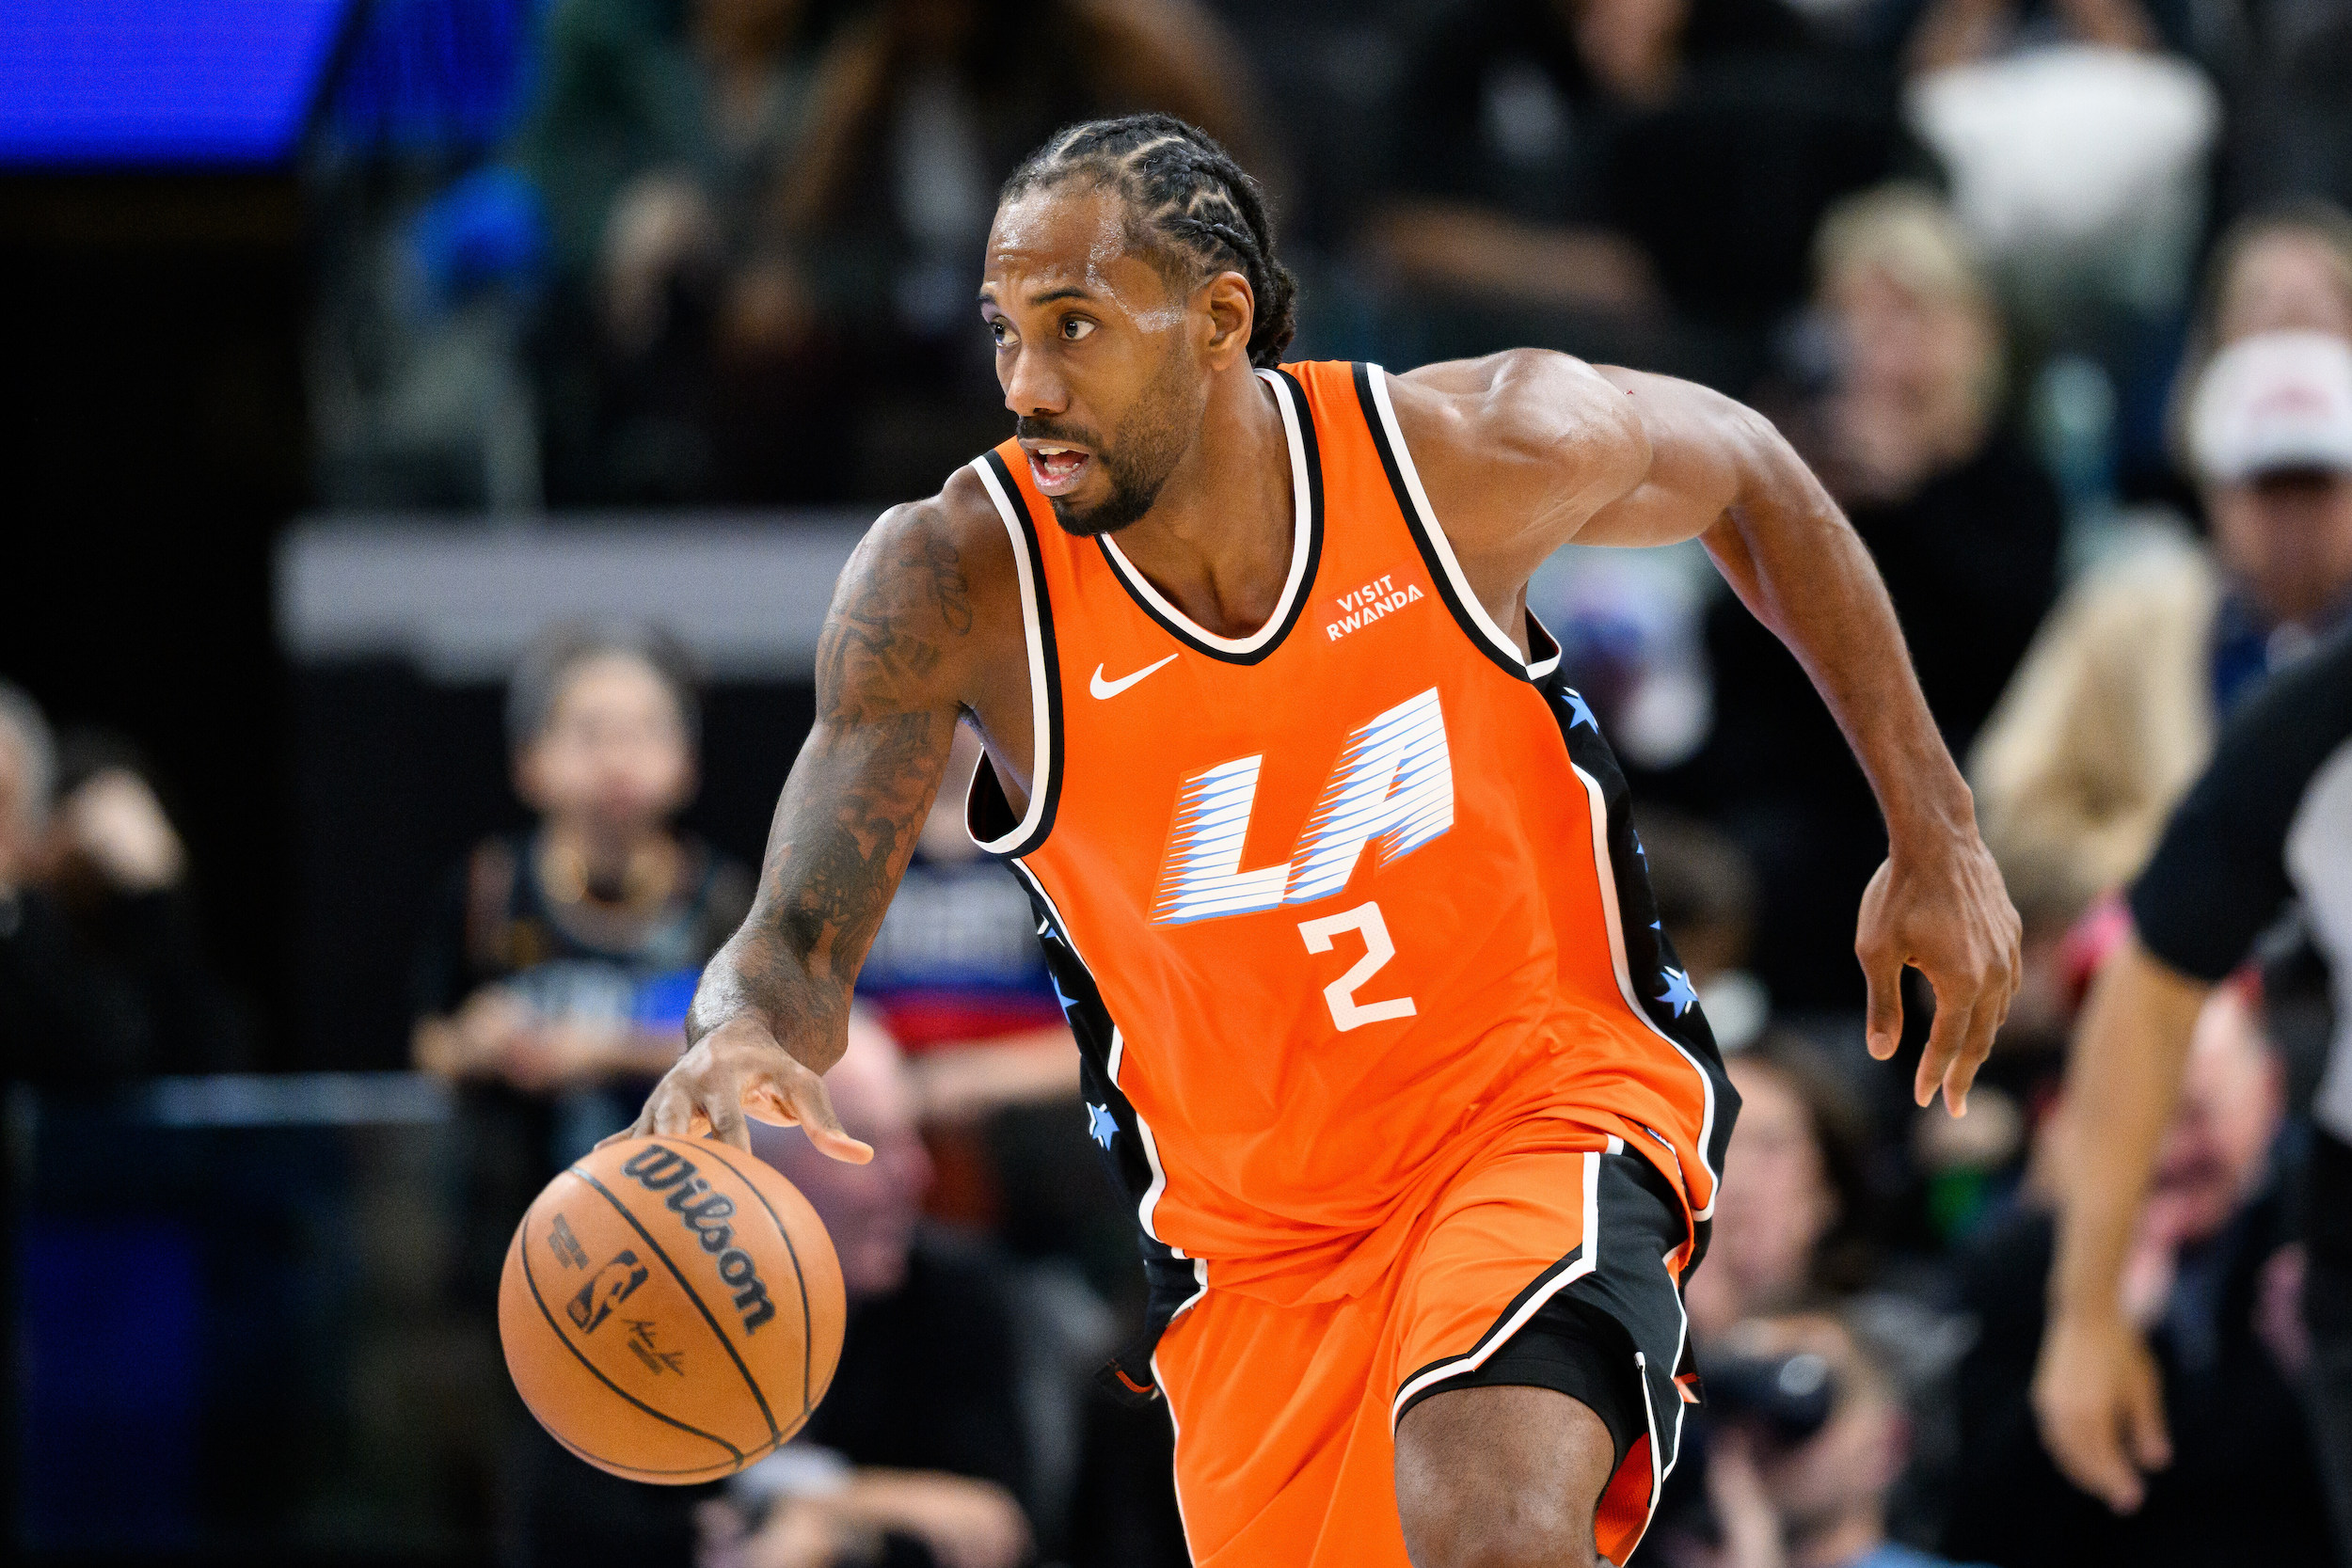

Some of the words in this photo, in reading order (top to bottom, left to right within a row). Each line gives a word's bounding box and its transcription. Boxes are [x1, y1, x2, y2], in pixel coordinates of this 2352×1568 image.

[1326, 584, 1424, 641] RWANDA
[1337, 575, 1393, 612] VISIT
[1150, 686, 1454, 926] LA
[1297, 901, 1418, 1032] 2
[620, 1143, 776, 1337] Wilson
